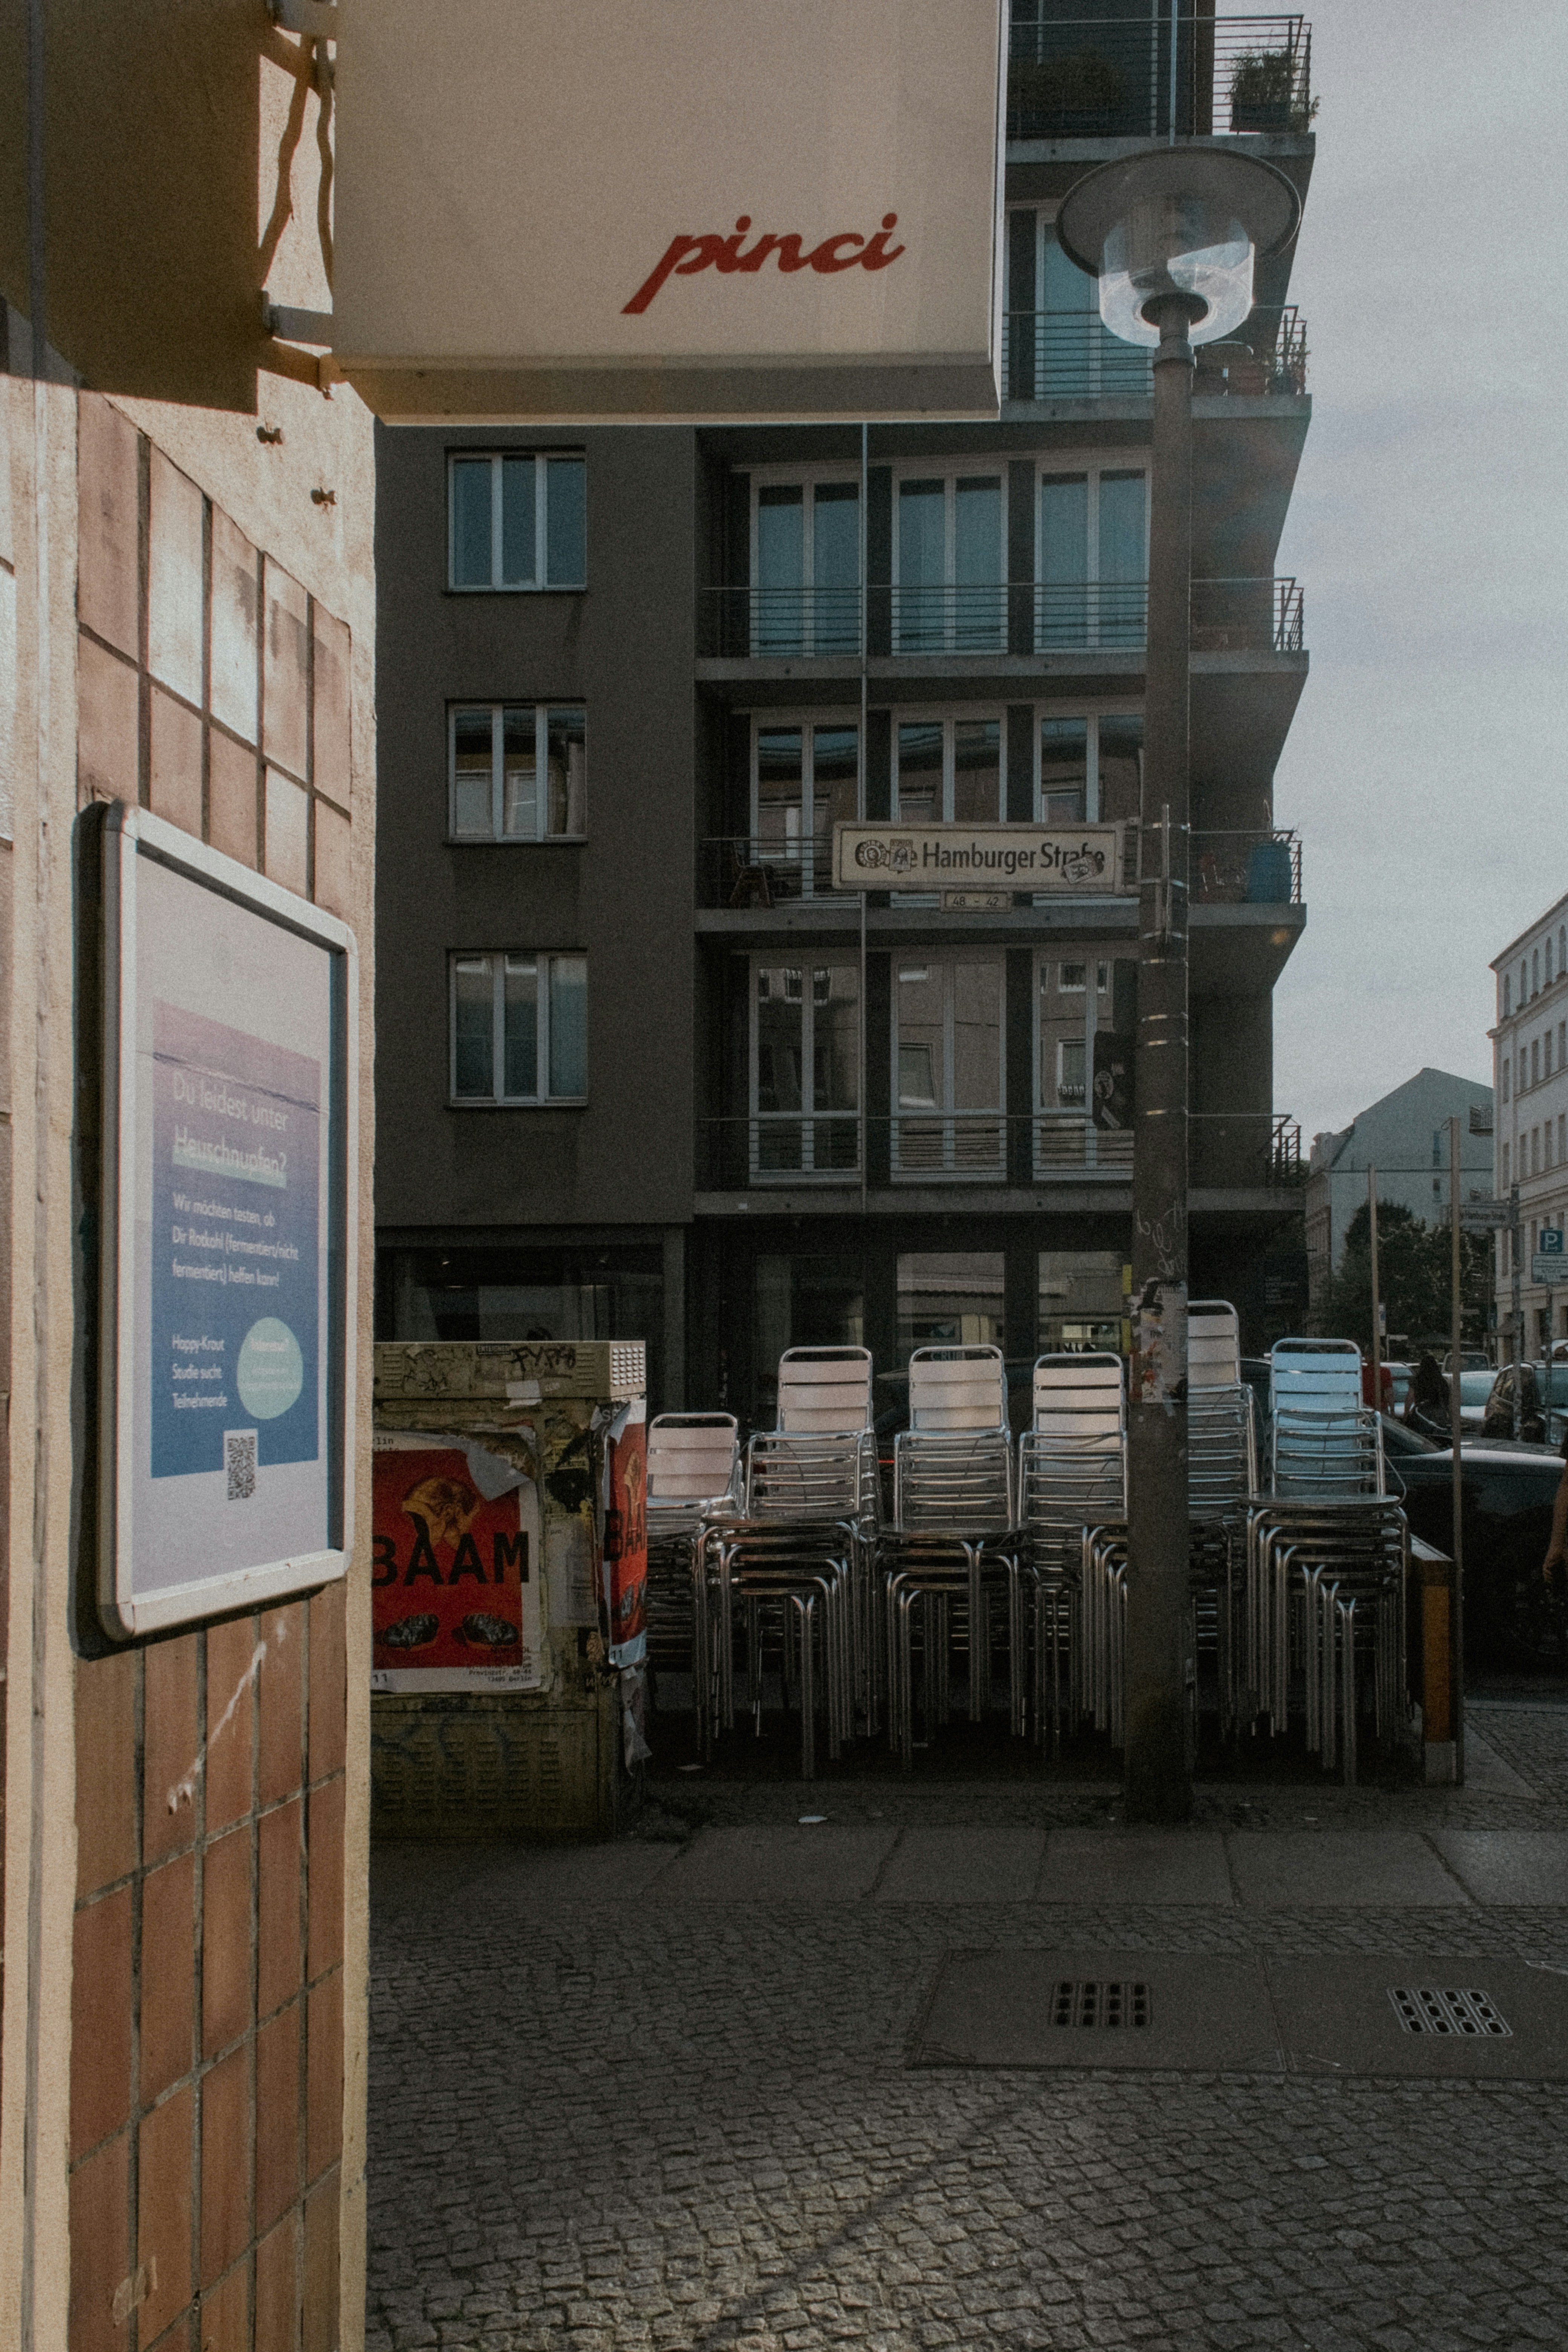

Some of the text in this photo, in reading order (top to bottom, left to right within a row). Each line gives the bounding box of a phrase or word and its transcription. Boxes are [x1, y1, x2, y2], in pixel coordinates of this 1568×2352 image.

[620, 213, 905, 314] pinci
[922, 841, 1036, 874] Hamburger
[953, 896, 966, 906] 48
[987, 896, 999, 906] 42
[173, 1072, 289, 1132] Du leidest unter
[173, 1124, 287, 1176] Heuschnupfen?
[172, 1191, 190, 1213] Wir
[193, 1200, 232, 1220] möchten
[263, 1210, 276, 1227] ob
[172, 1225, 187, 1244] Dir
[189, 1228, 224, 1251] Rotkohl
[1544, 1232, 1558, 1250] P
[228, 1264, 254, 1284] helfen
[172, 1362, 199, 1380] Studie
[372, 1530, 530, 1586] BAAM
